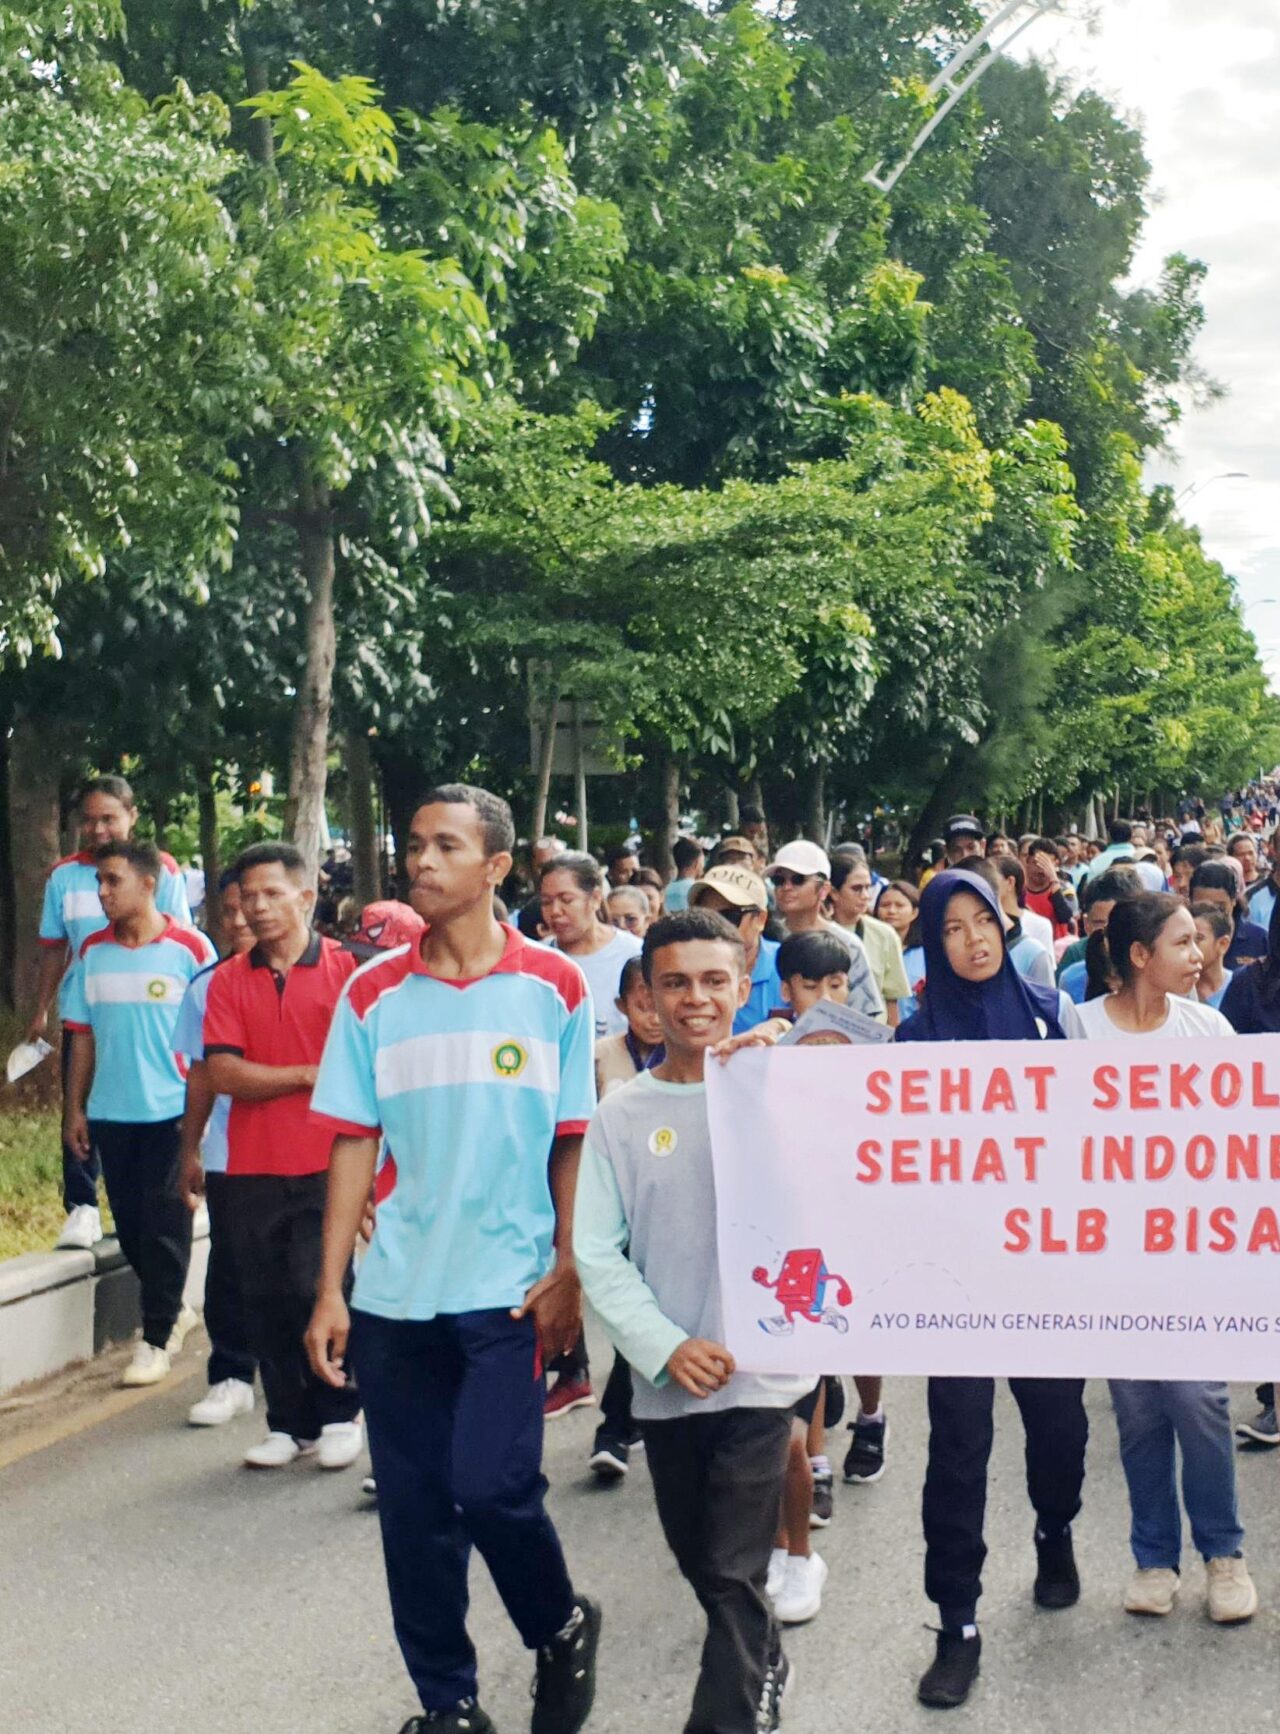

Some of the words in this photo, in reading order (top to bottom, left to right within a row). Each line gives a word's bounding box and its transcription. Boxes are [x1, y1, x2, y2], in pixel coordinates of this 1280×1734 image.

[866, 1064, 1057, 1115] SEHAT
[855, 1135, 1047, 1185] SEHAT
[1002, 1206, 1109, 1255] SLB
[870, 1312, 911, 1330] AYO
[915, 1312, 997, 1331] BANGUN
[1001, 1313, 1094, 1331] GENERASI
[1098, 1314, 1208, 1333] INDONESIA
[1212, 1316, 1270, 1333] YANG
